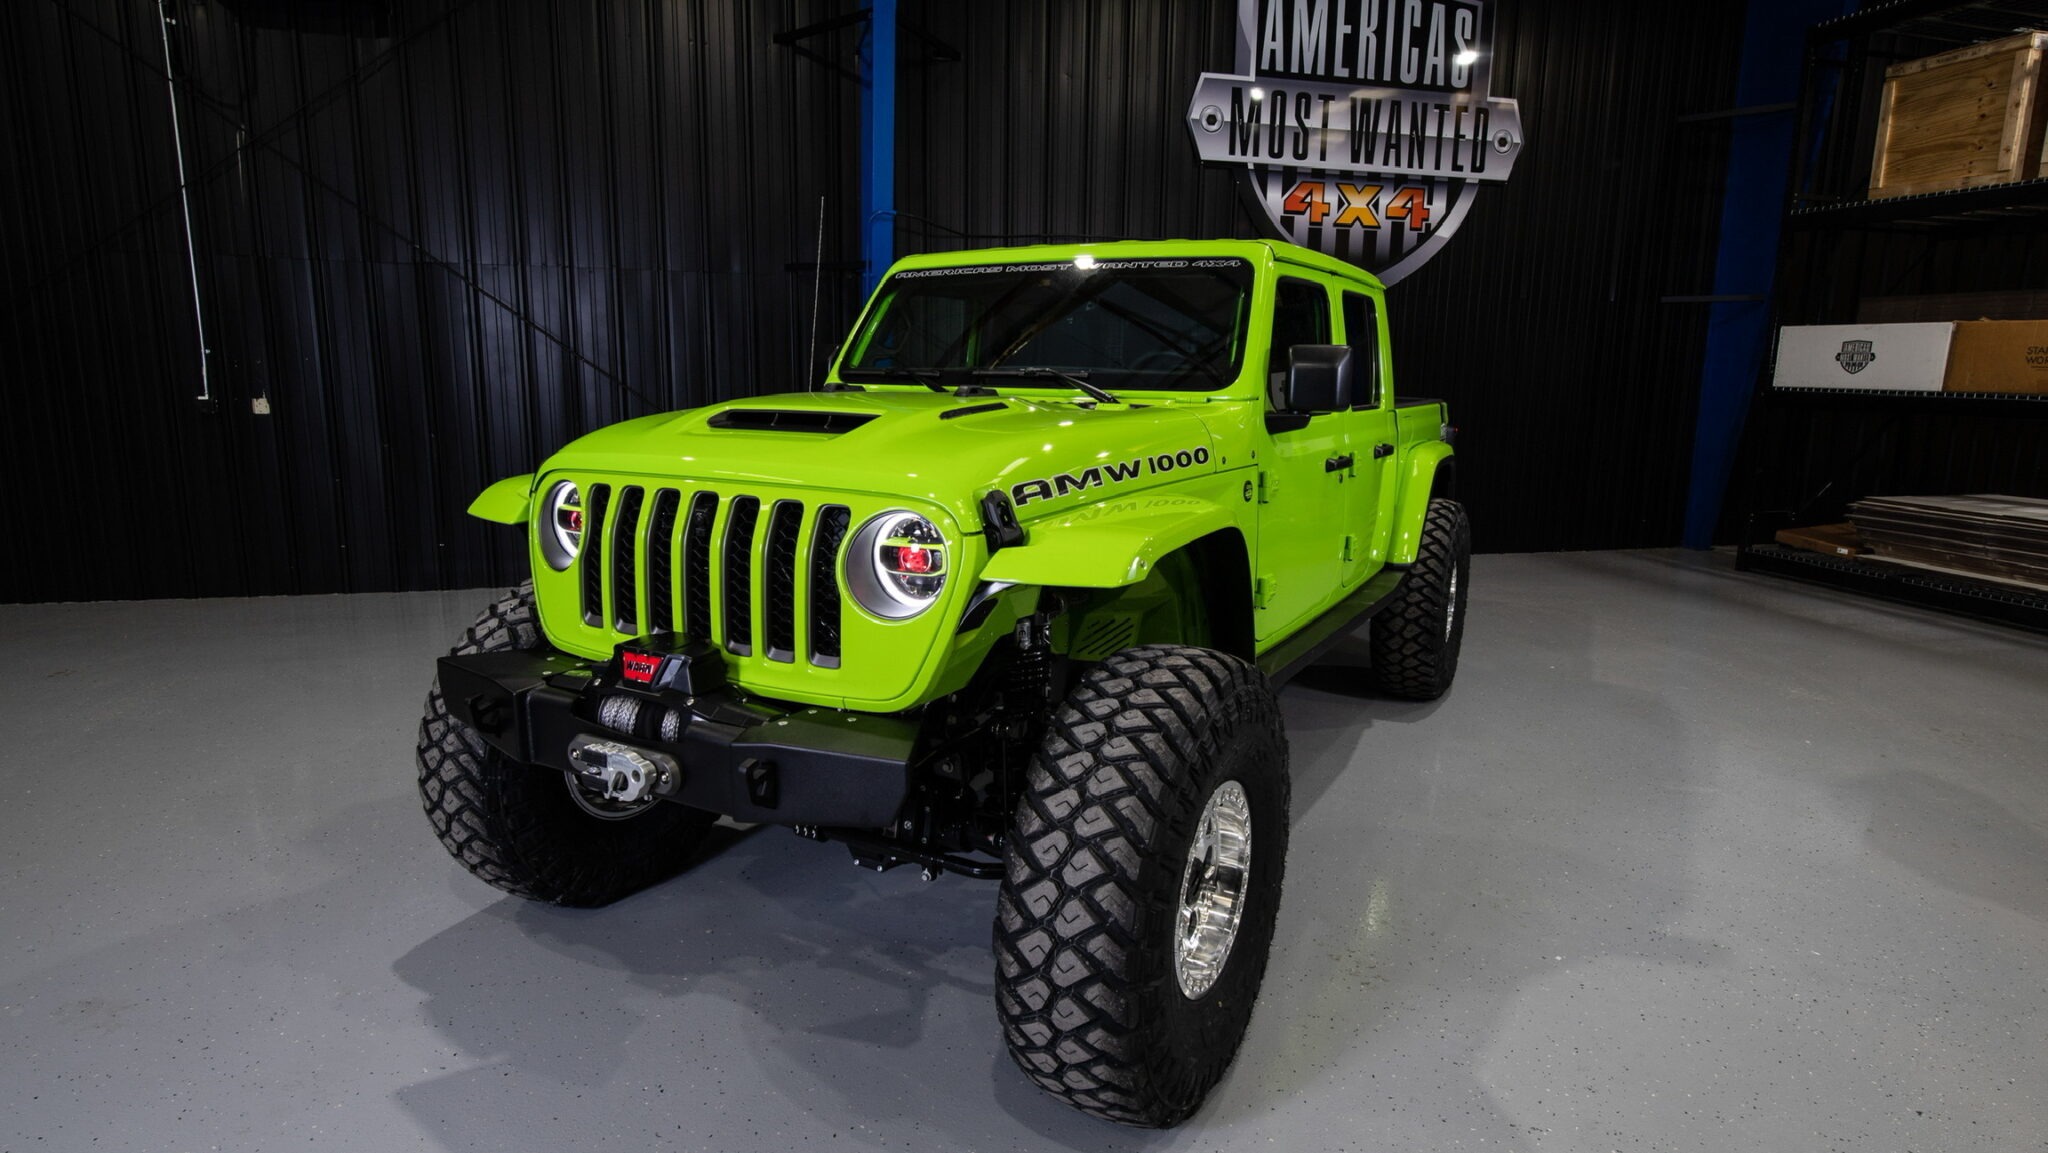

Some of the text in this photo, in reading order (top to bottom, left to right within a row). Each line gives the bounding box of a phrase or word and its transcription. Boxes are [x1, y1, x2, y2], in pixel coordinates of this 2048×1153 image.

[1260, 0, 1473, 89] AMERICAS
[1228, 86, 1490, 174] MOST WANTED
[1283, 180, 1431, 232] 4X4
[895, 265, 1003, 279] AMERICAS
[1005, 263, 1073, 272] MOST
[1010, 445, 1210, 508] AMW 1000
[627, 660, 654, 674] WARN
